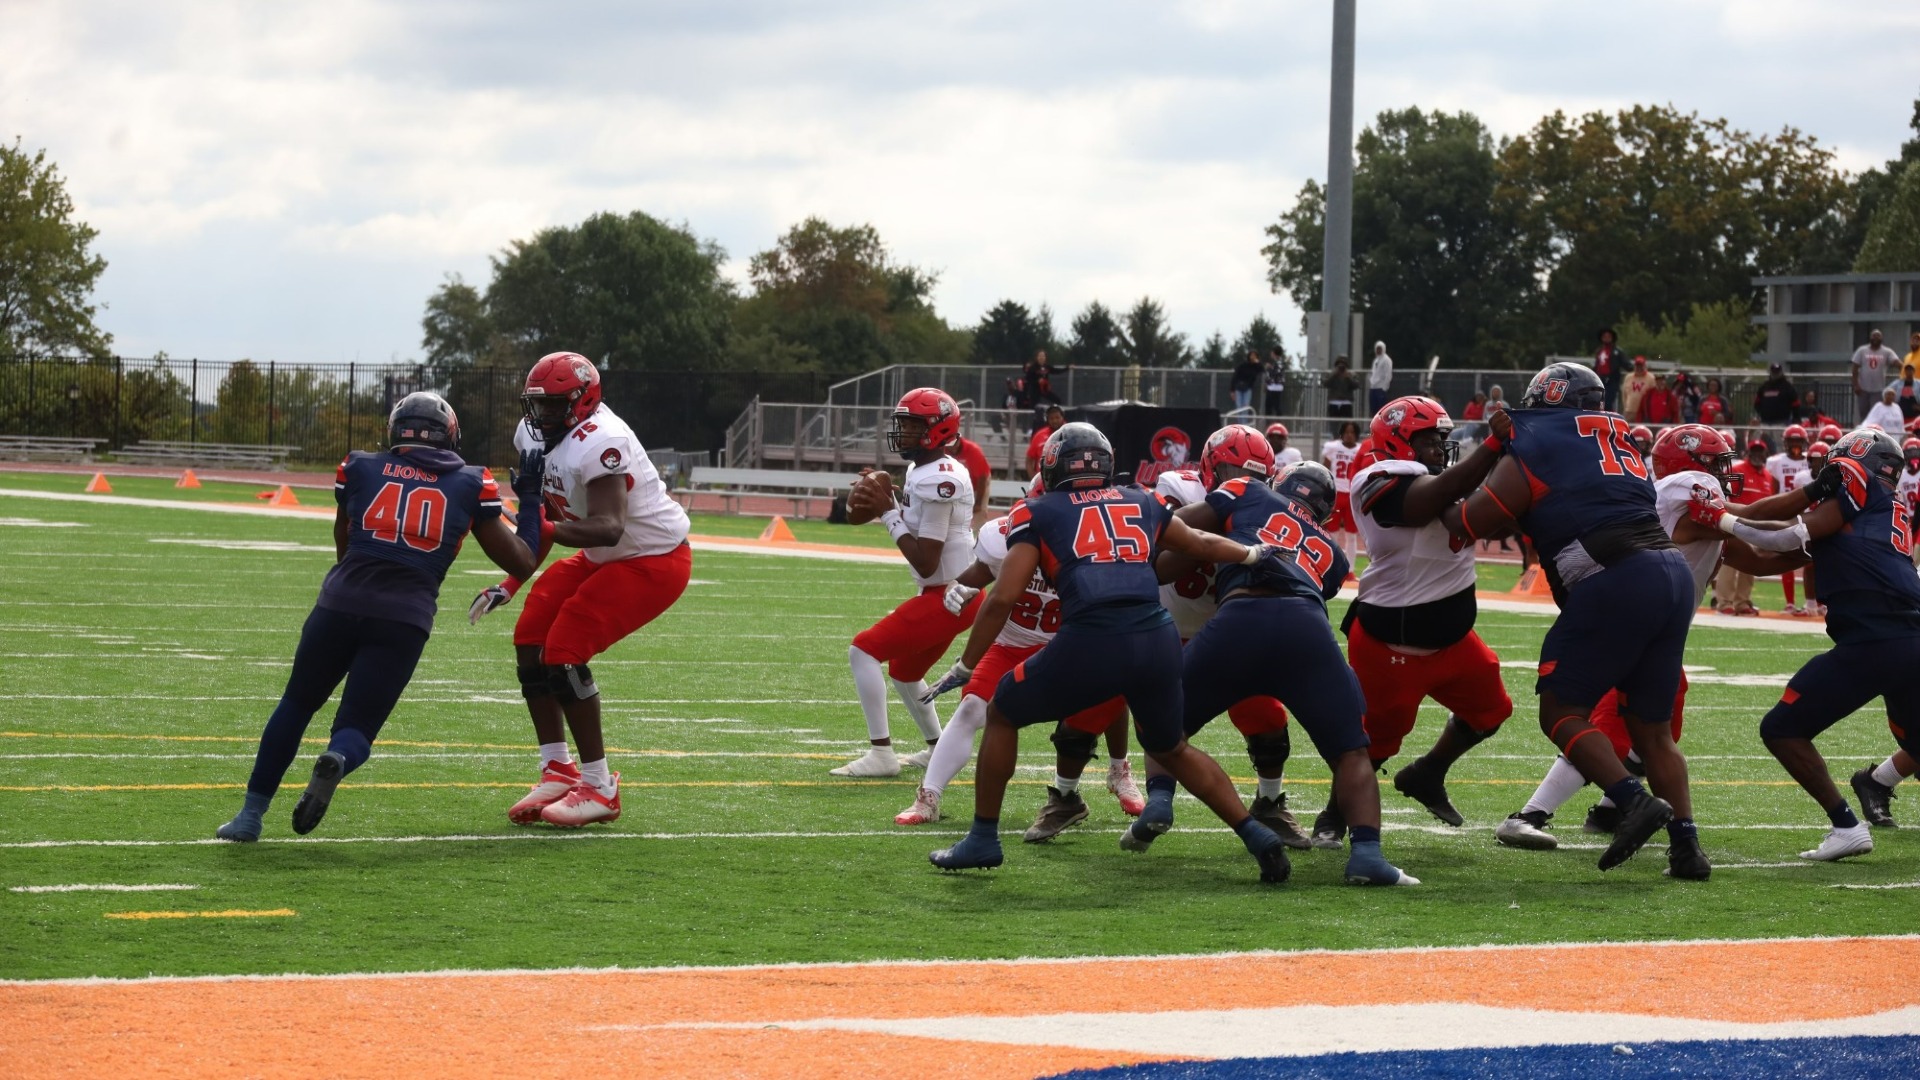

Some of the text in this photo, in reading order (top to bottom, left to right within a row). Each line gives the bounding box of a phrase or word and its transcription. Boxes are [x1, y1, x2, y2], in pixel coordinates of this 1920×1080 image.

[572, 421, 599, 442] 75
[1575, 415, 1649, 481] 75
[382, 463, 438, 483] LIONS
[1068, 487, 1124, 505] LIONS
[362, 482, 448, 553] 40
[1072, 504, 1150, 563] 45
[1256, 512, 1334, 591] 92
